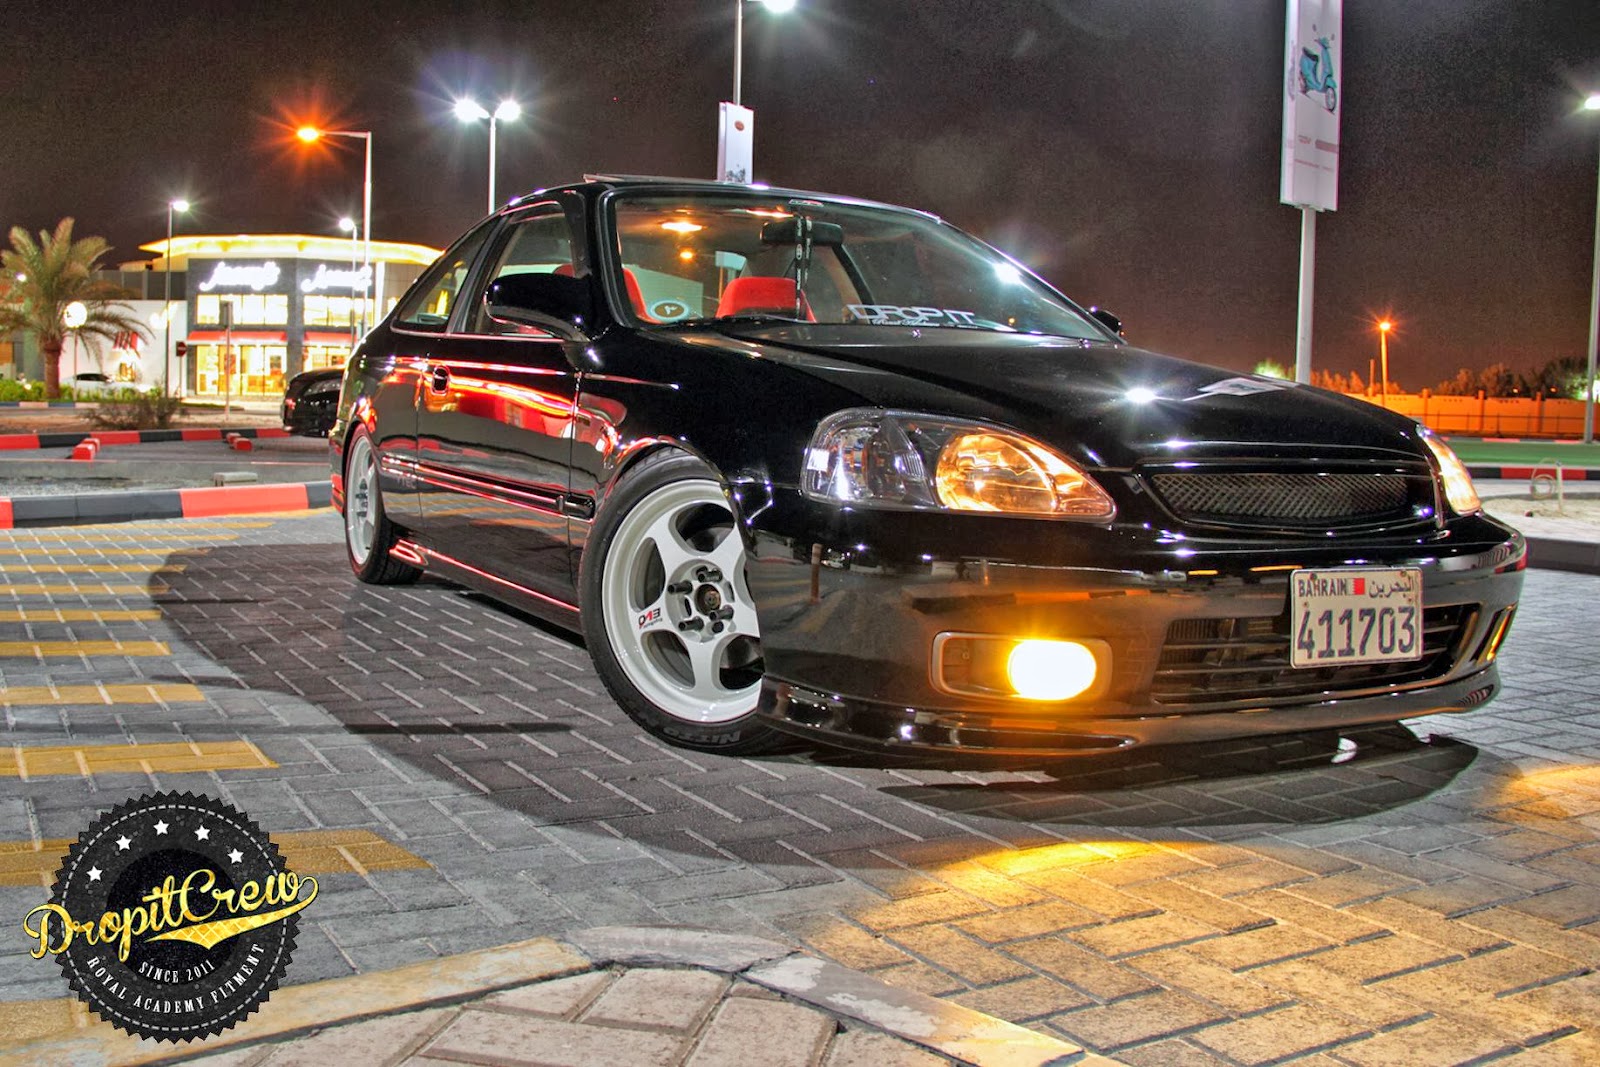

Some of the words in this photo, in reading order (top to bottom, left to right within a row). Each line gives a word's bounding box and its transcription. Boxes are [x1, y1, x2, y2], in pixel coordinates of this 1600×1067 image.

[1298, 578, 1347, 597] BAHRAIN
[1369, 574, 1414, 598] البحرين
[1297, 606, 1415, 659] 411703
[663, 726, 742, 744] NITTO
